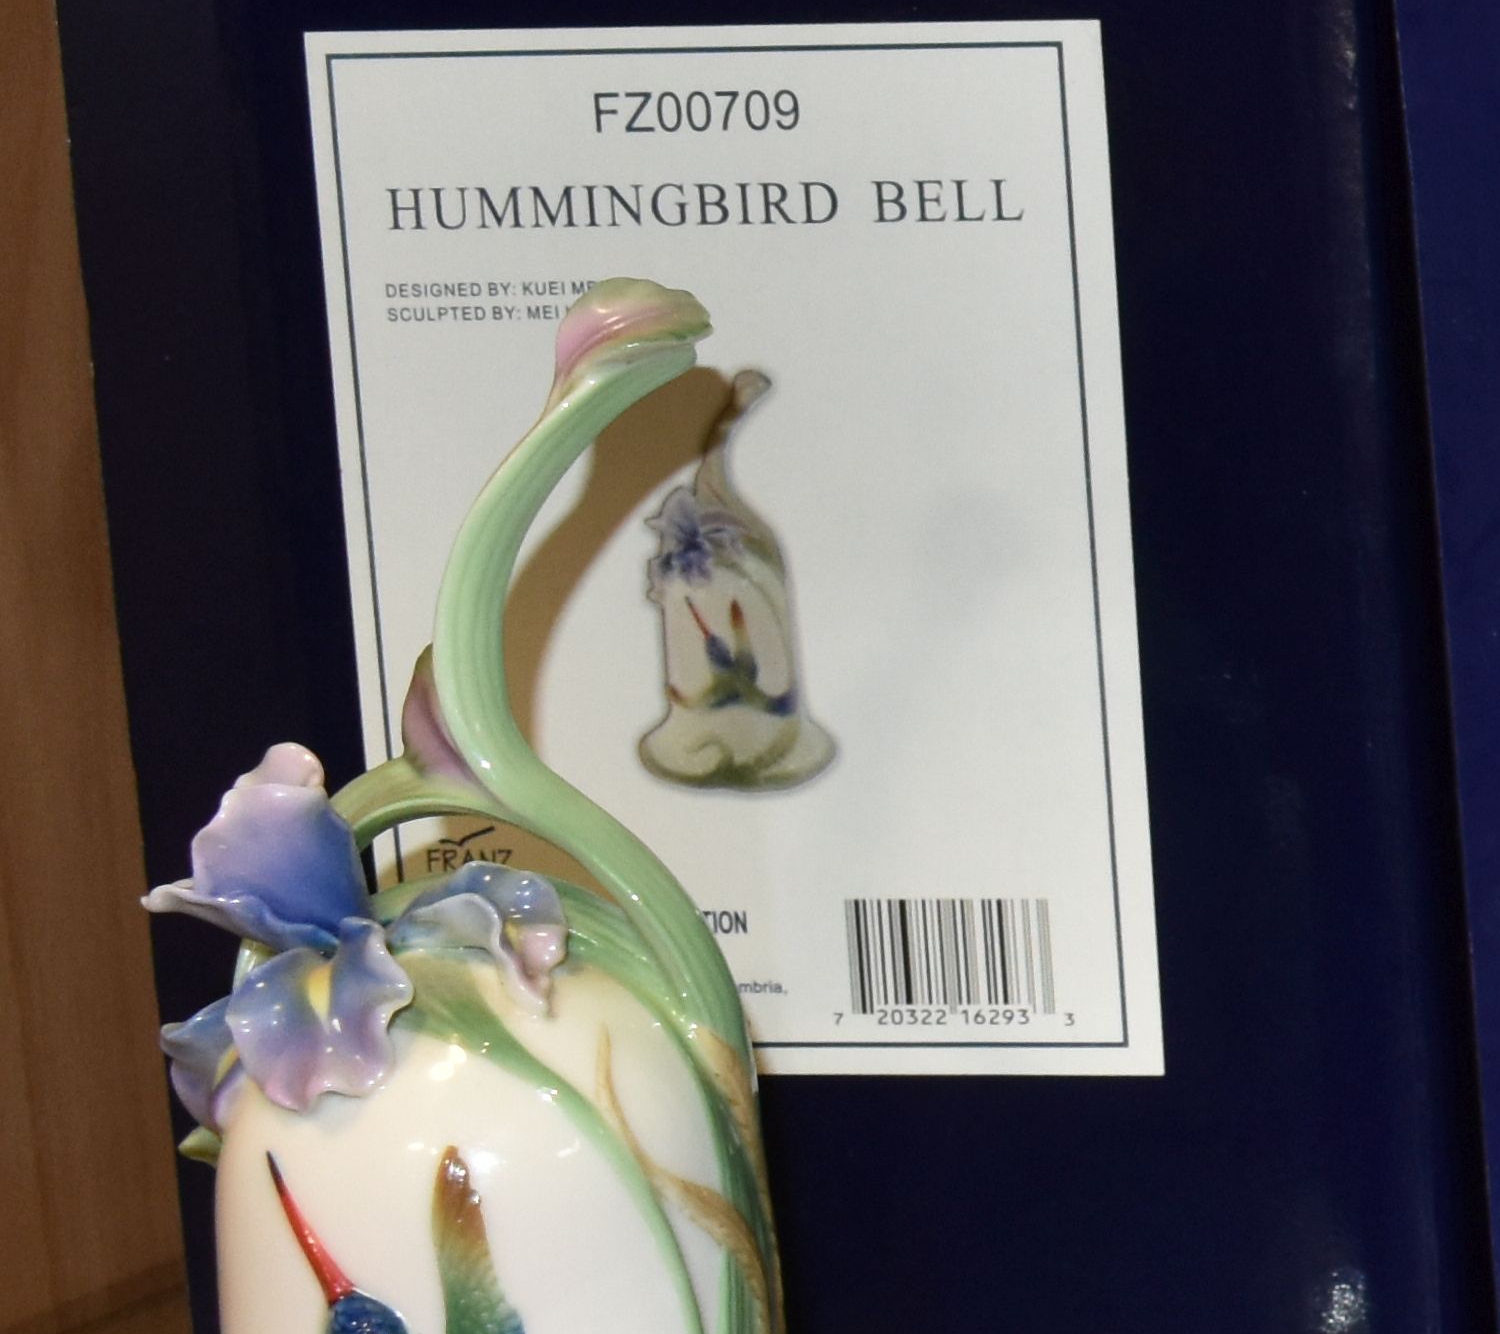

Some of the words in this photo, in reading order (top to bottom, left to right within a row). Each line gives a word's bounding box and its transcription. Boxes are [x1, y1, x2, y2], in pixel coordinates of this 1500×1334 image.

[593, 89, 800, 133] FZ00709
[386, 180, 840, 230] HUMMINGBIRD
[872, 179, 1024, 224] BELL
[385, 282, 481, 298] DESIGNED
[488, 281, 517, 296] BY:
[522, 280, 566, 295] KUEI
[572, 280, 597, 294] ME
[387, 307, 487, 322] SCULPTED
[492, 306, 521, 320] BY:
[527, 304, 560, 319] MEI
[737, 980, 788, 995] mbria,
[876, 1008, 948, 1026] 20322
[961, 1008, 1031, 1026] 16293
